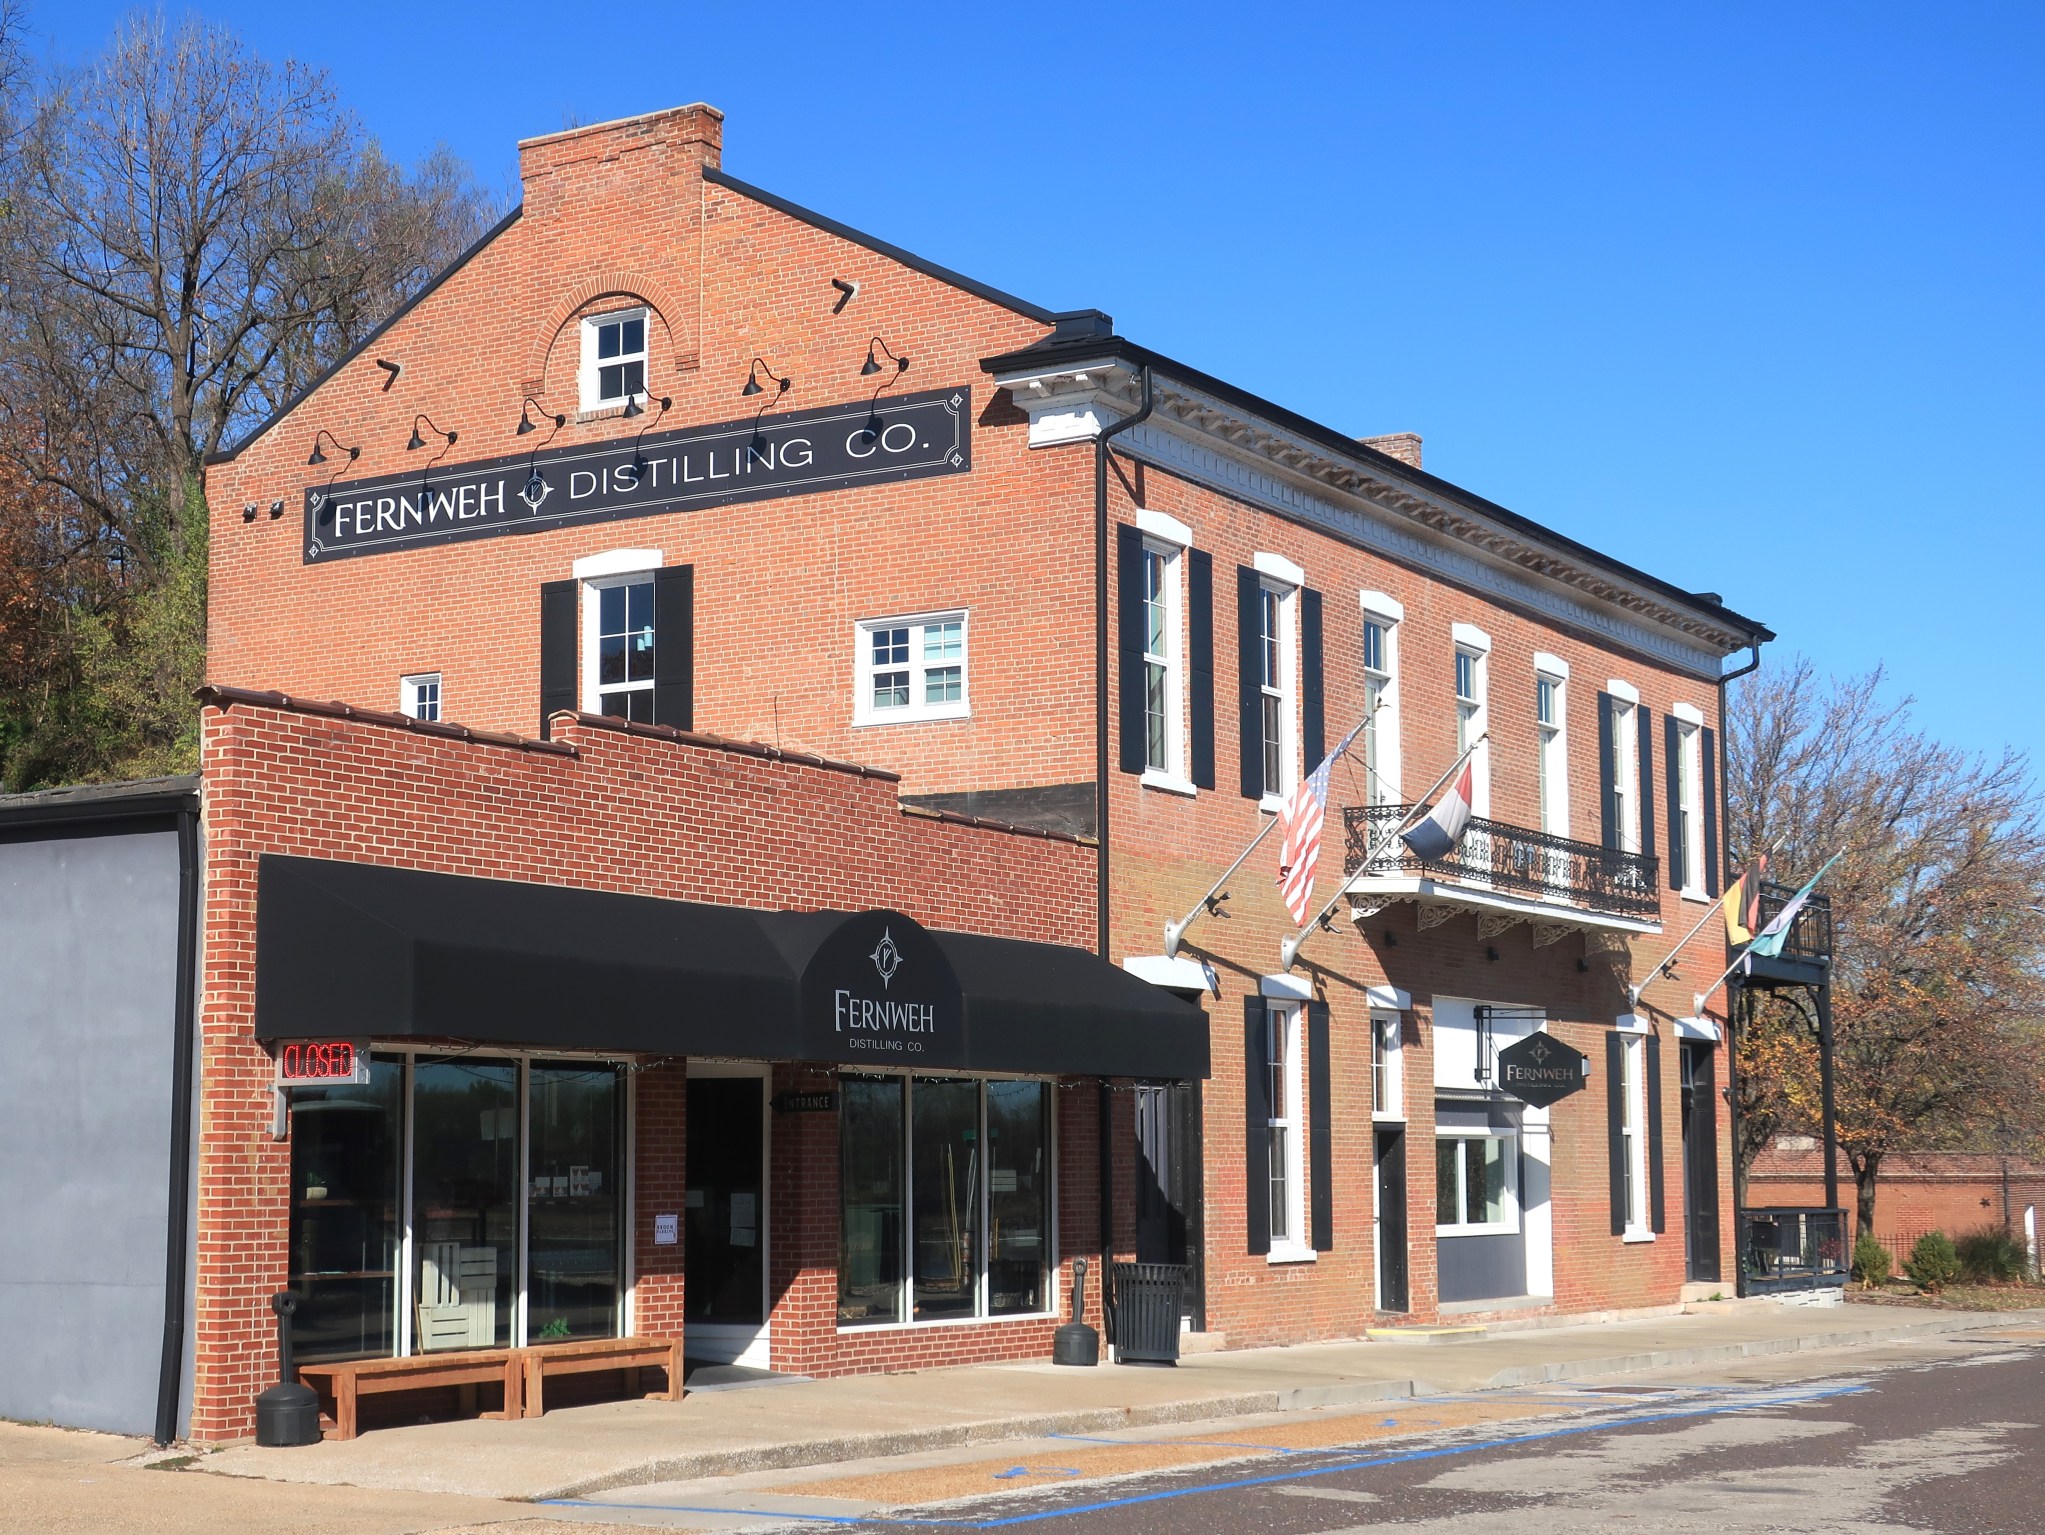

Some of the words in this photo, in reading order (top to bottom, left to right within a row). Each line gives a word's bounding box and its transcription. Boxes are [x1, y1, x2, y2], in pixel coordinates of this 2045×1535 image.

[335, 480, 506, 538] FERNWEH
[569, 438, 814, 500] DISTILLING
[844, 423, 930, 459] CO.
[835, 989, 935, 1033] FERNWEH
[849, 1038, 903, 1051] DISTILLING
[907, 1041, 925, 1052] CO.
[284, 1042, 354, 1079] CLOSED
[1506, 1064, 1574, 1081] FERNWEH
[783, 1096, 830, 1110] ENTRANCE
